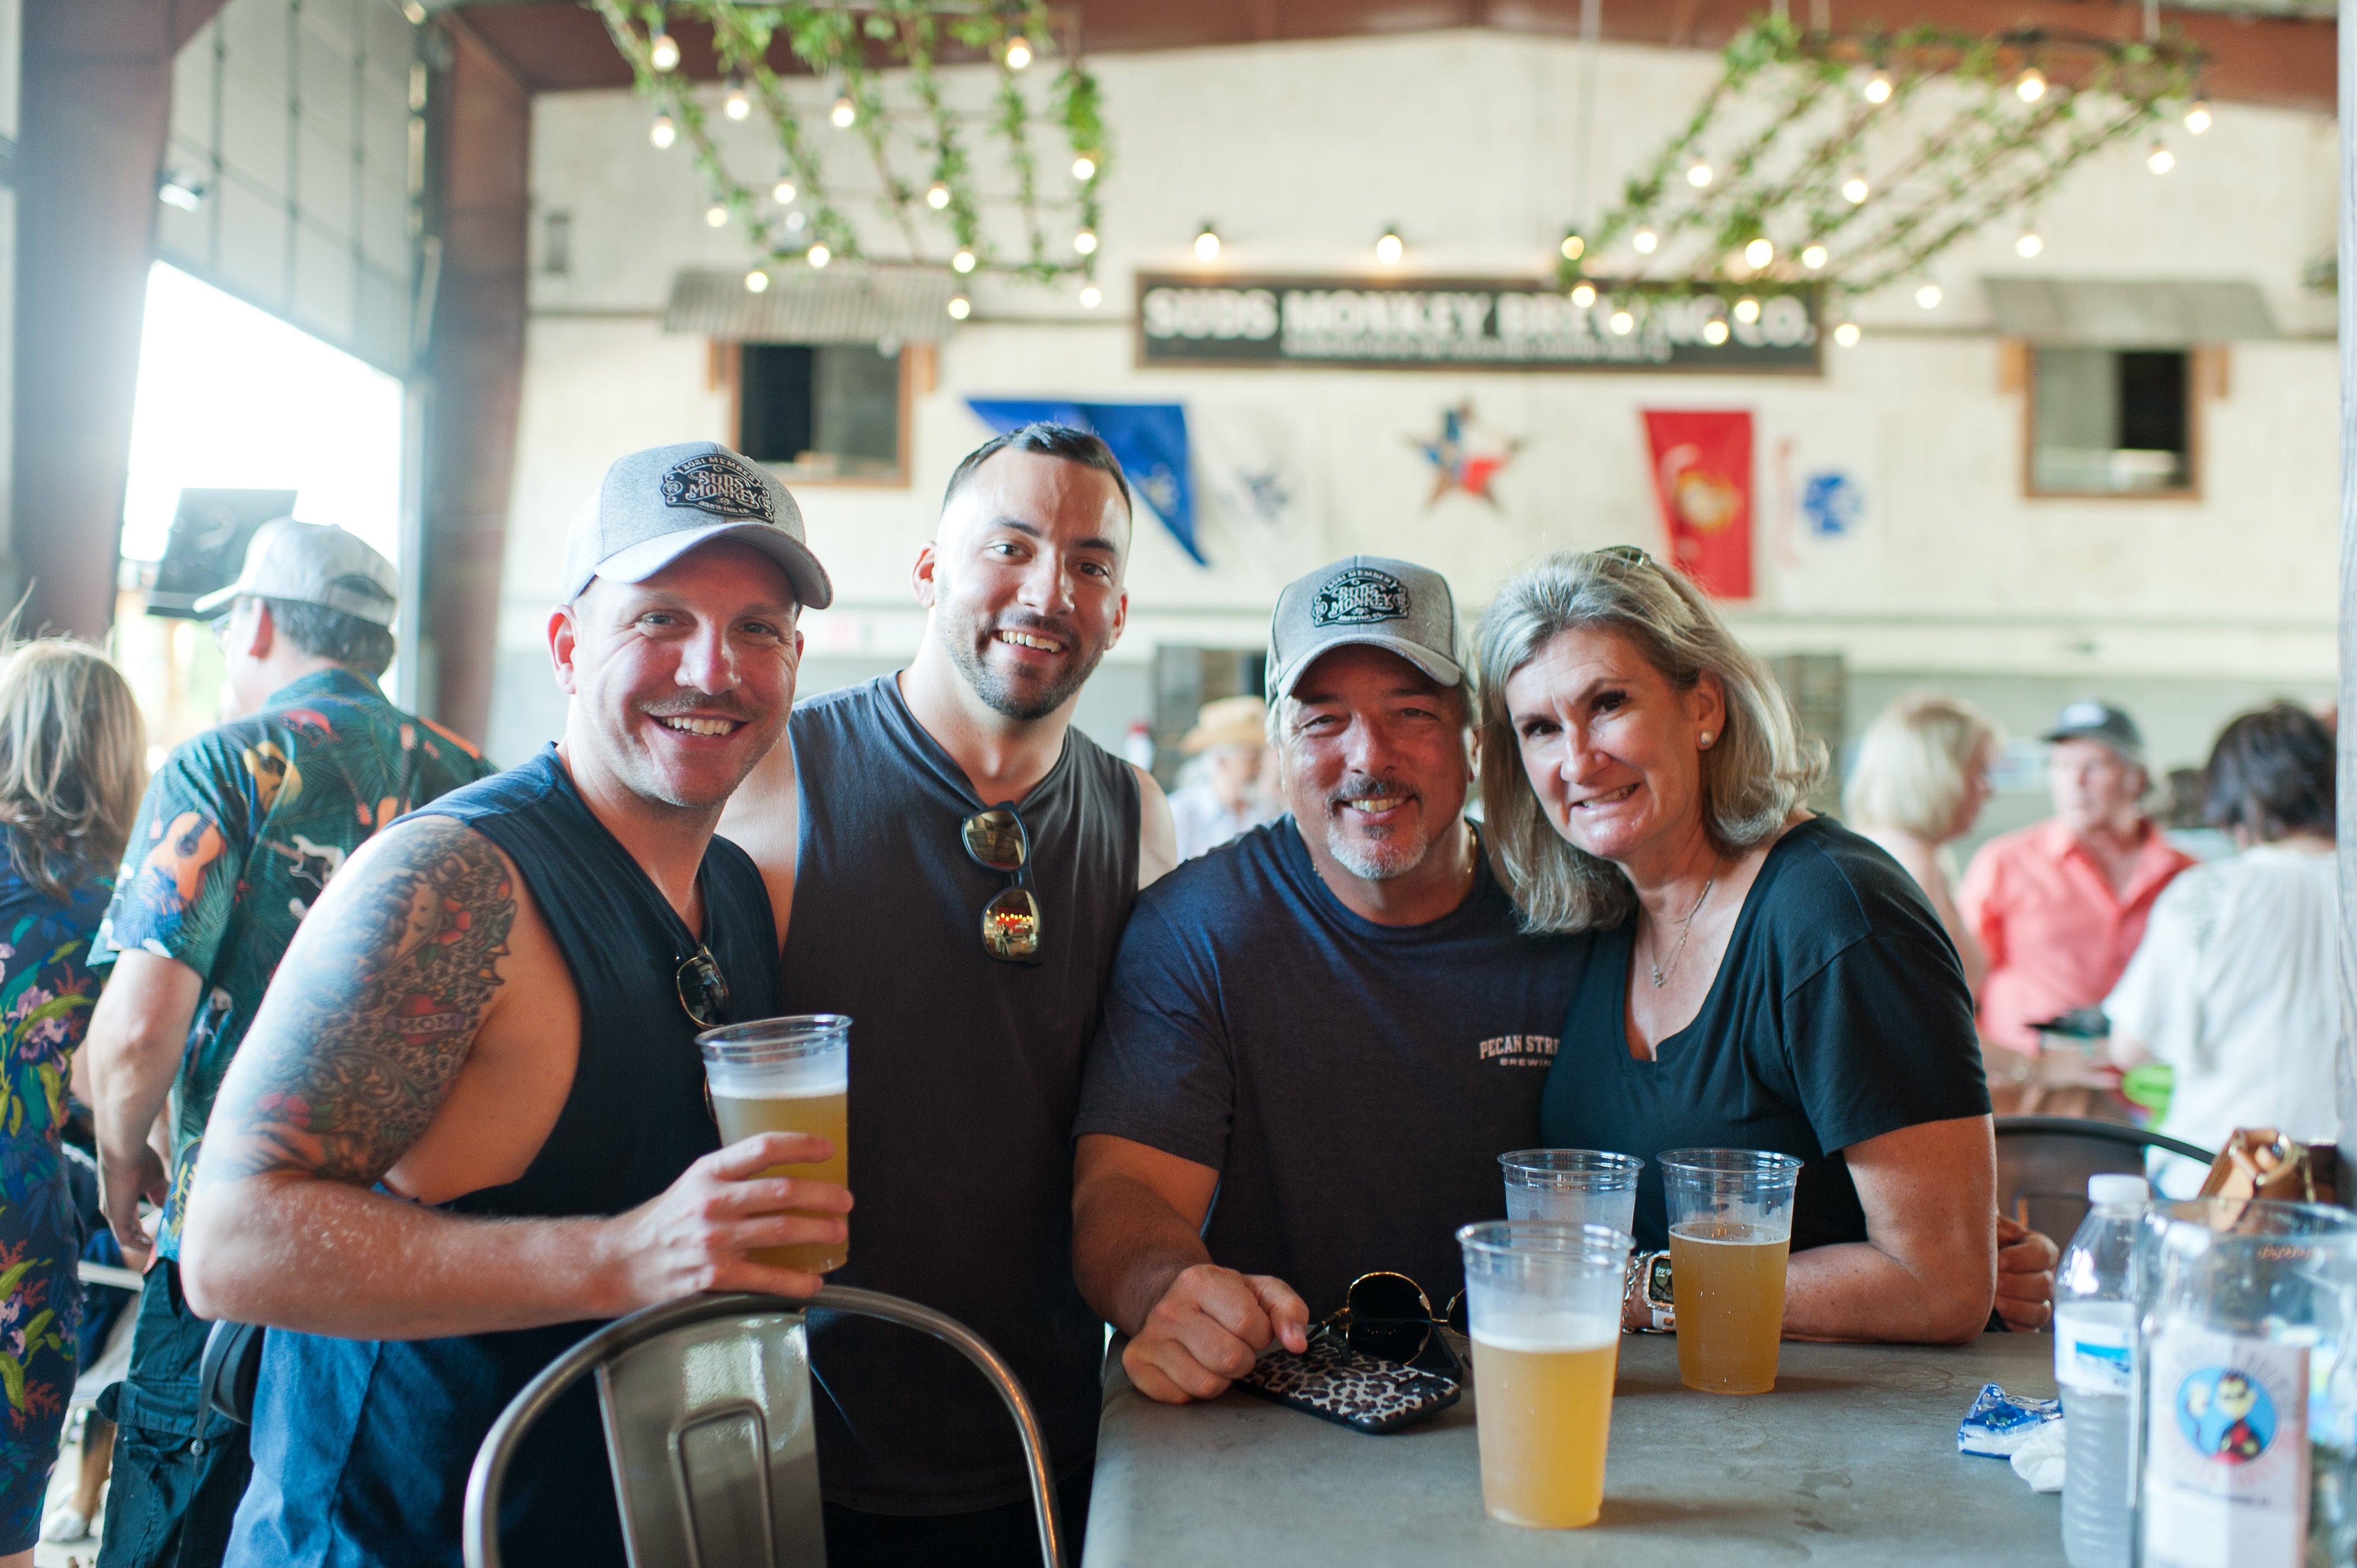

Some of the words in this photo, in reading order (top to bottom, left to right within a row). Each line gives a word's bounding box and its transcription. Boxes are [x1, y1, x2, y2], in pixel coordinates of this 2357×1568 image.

[1143, 288, 1278, 339] SUDS
[1281, 289, 1493, 338] MONKEY
[682, 458, 706, 470] 2021
[709, 457, 755, 482] MEMBER
[688, 470, 750, 489] SUDS
[686, 483, 759, 507] MONKEY
[698, 501, 738, 513] BREWING
[1329, 592, 1393, 617] MONKEY
[395, 1014, 456, 1033] MOM
[1479, 1034, 1522, 1060] PECAN
